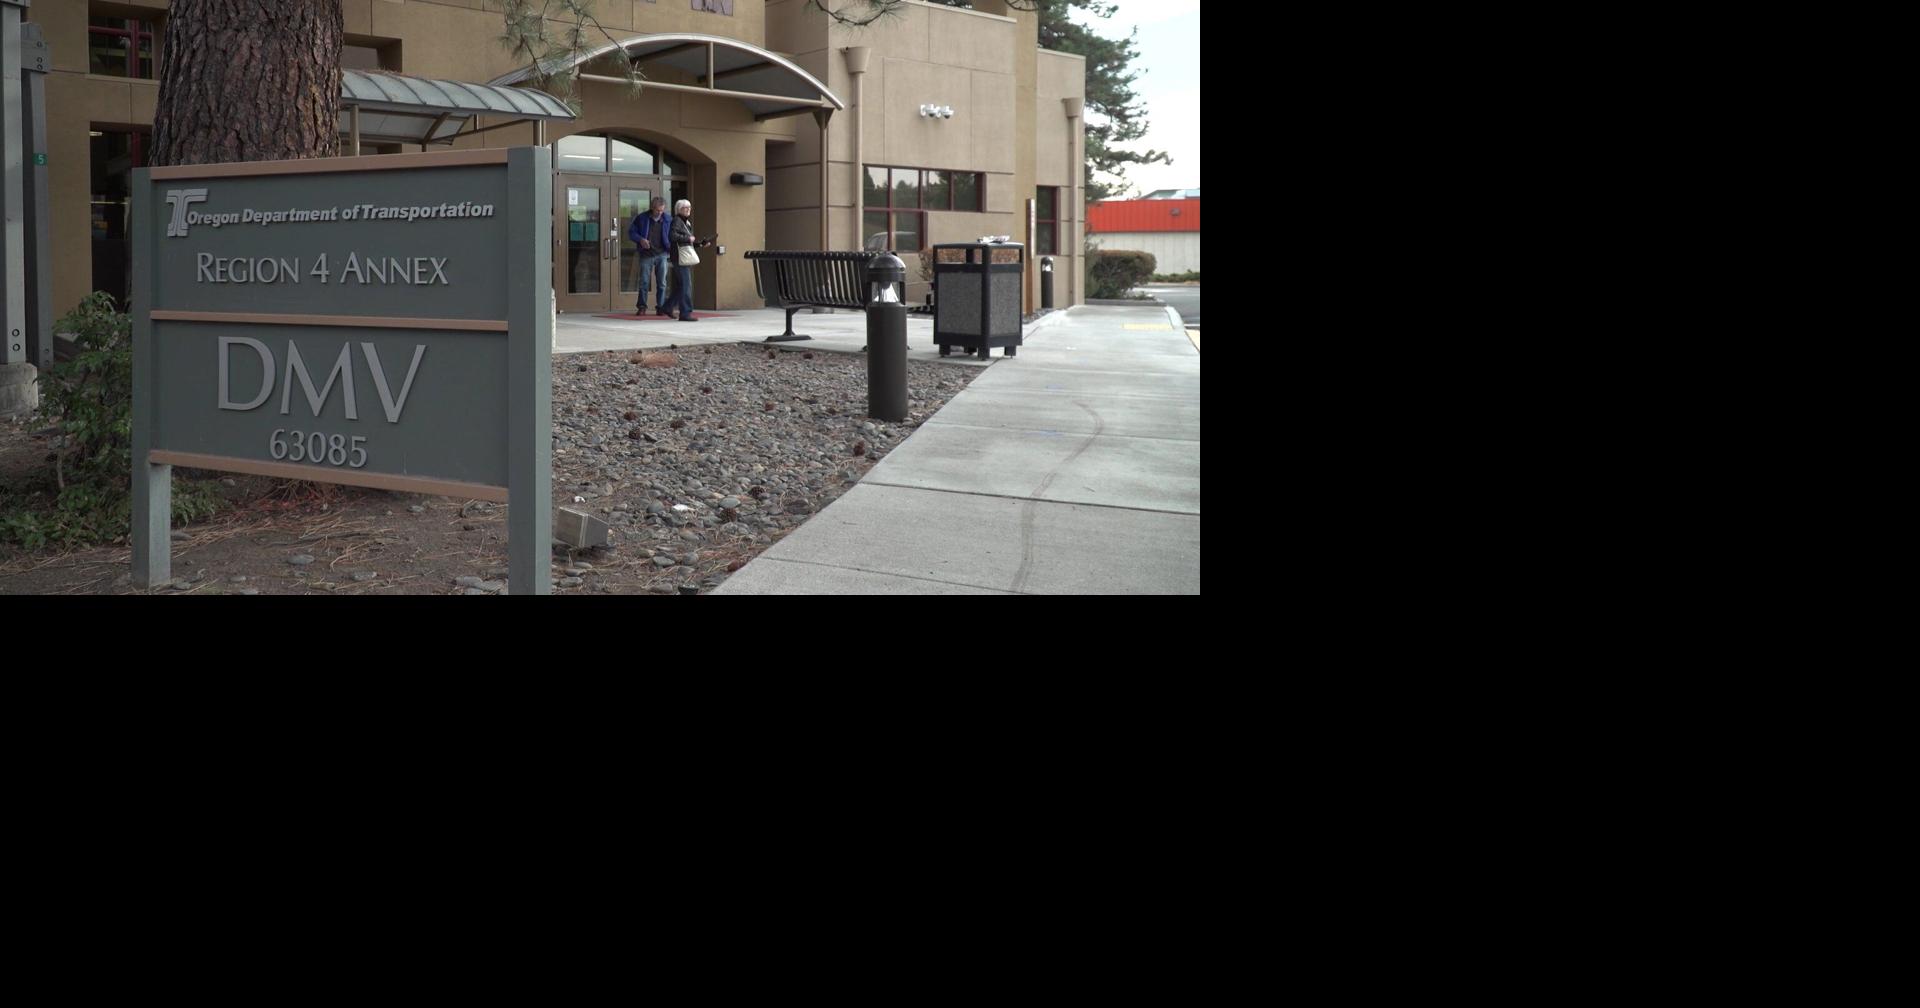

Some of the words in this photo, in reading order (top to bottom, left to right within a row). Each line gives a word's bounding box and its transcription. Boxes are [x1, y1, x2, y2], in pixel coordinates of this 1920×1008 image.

[186, 210, 240, 228] Oregon
[242, 207, 338, 227] Department
[341, 206, 361, 221] of
[361, 201, 494, 222] Transportation
[197, 252, 300, 284] REGION
[309, 252, 330, 284] 4
[339, 251, 449, 285] ANNEX
[218, 335, 427, 424] DMV
[269, 428, 368, 468] 63085
